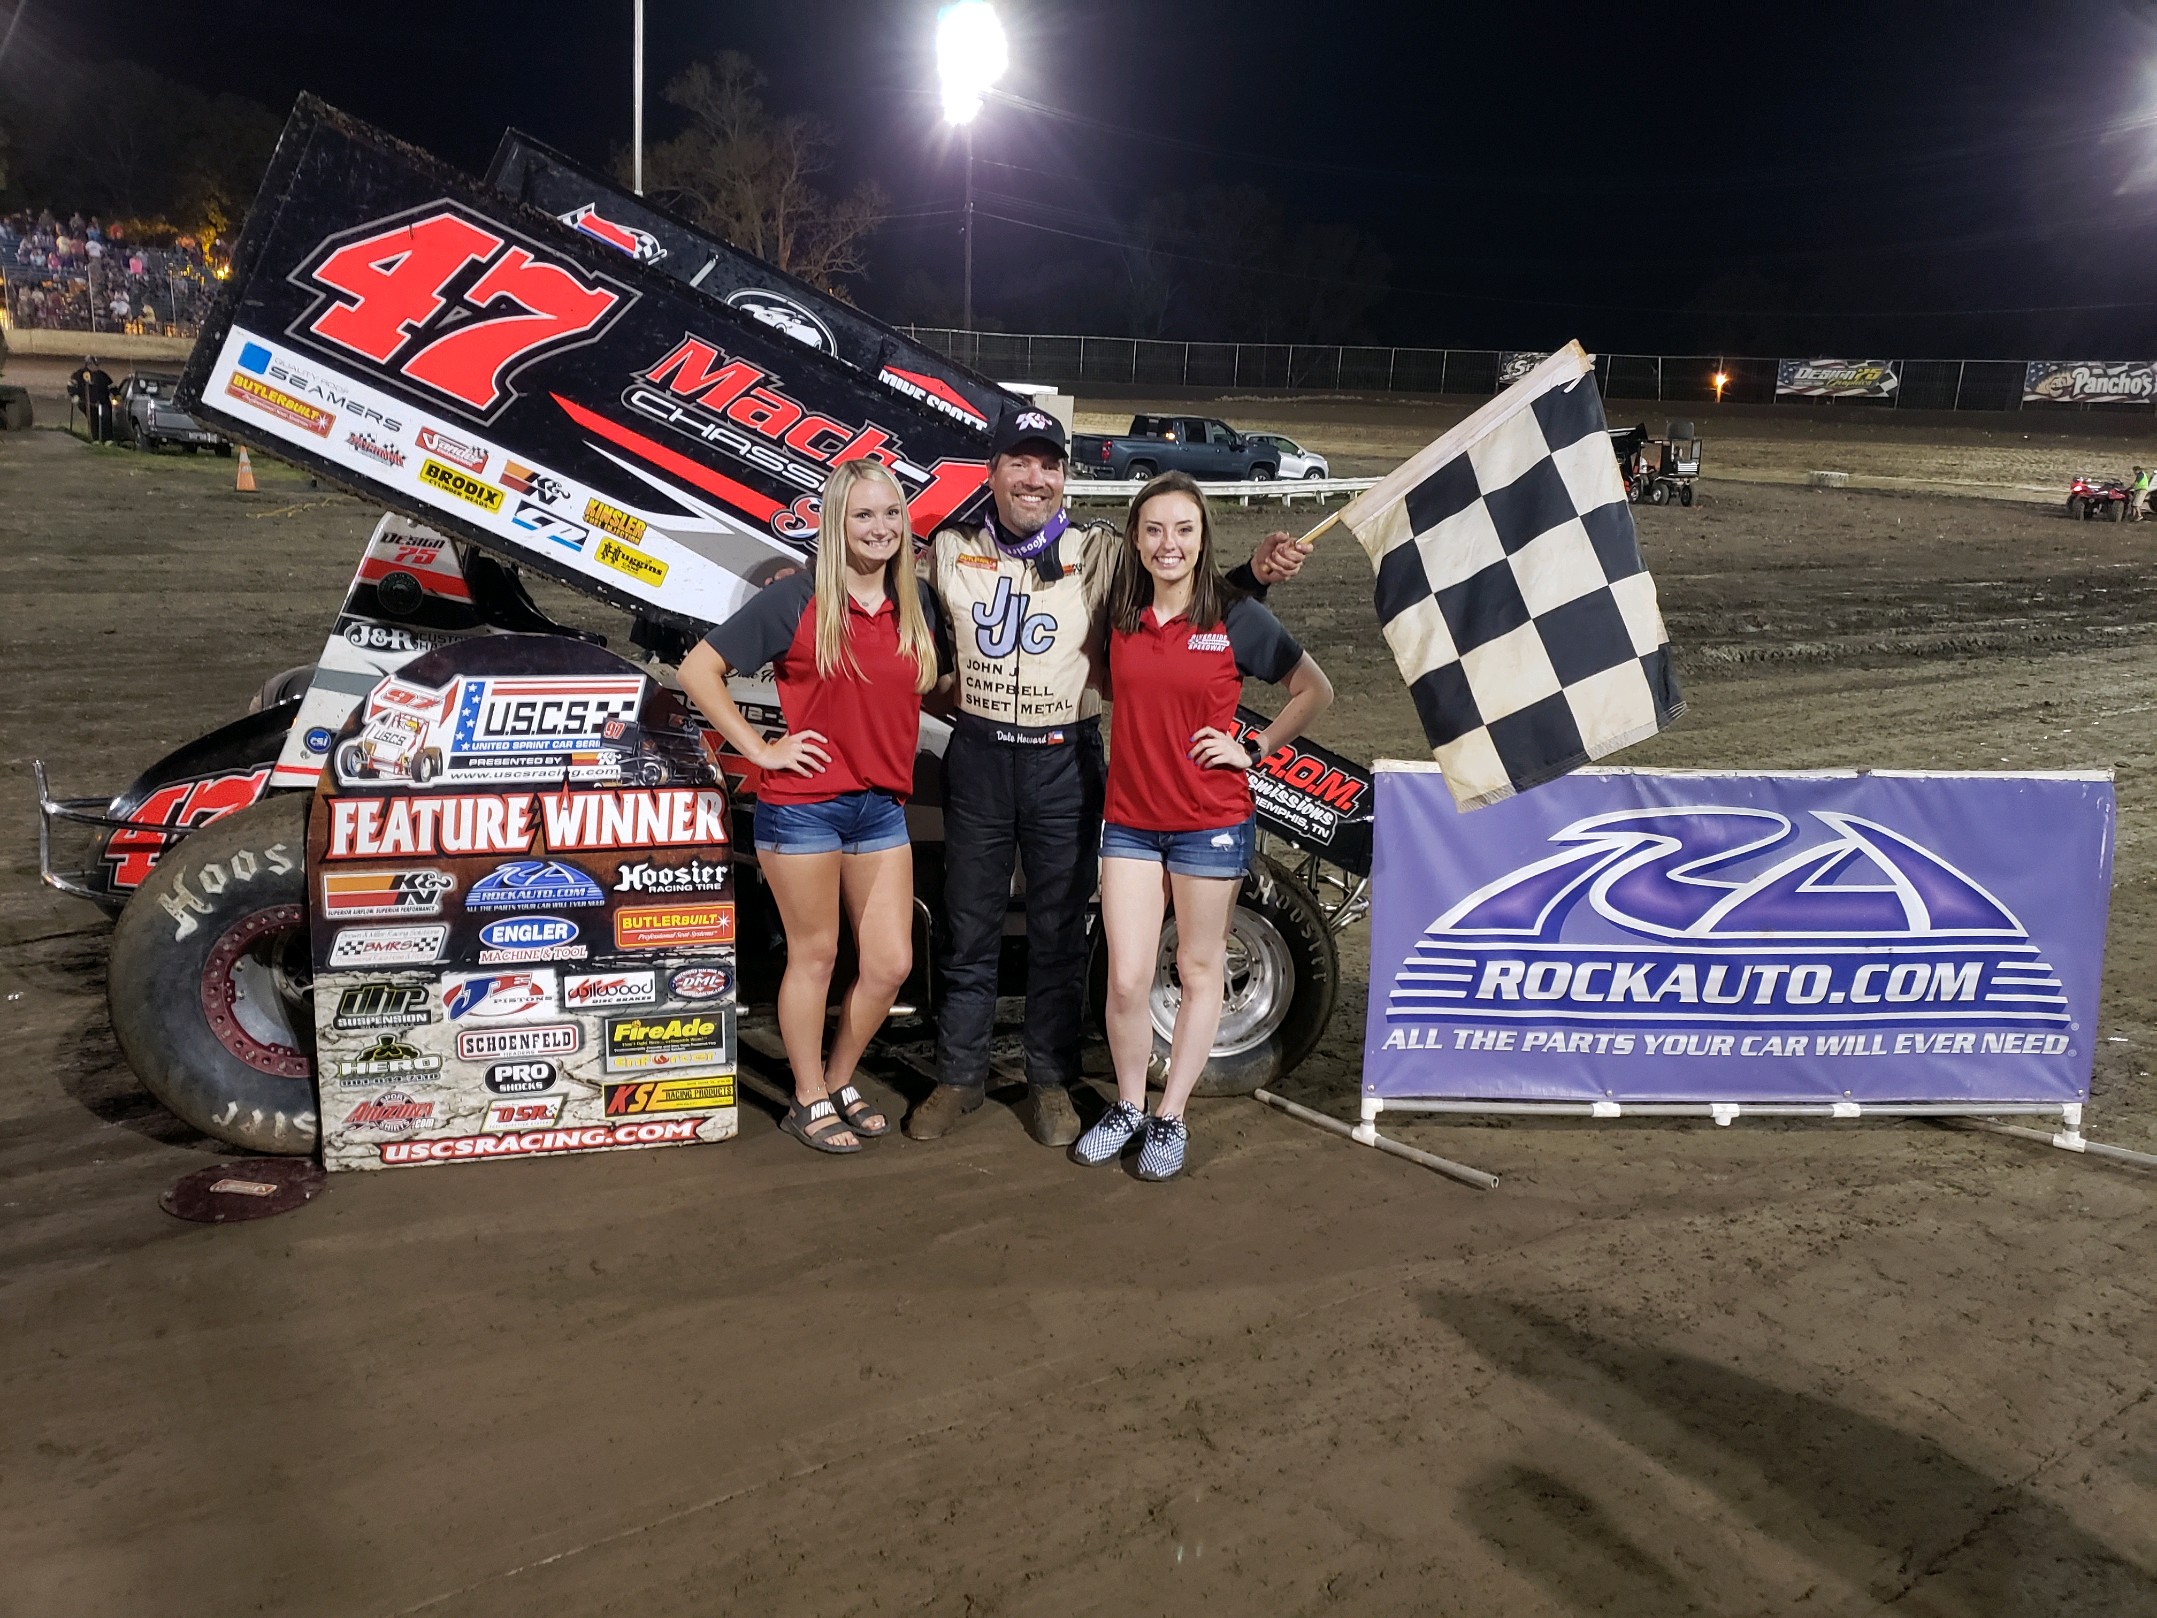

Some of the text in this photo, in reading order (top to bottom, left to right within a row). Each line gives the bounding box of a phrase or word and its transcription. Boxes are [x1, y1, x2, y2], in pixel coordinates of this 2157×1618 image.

[310, 213, 619, 410] 47
[2072, 367, 2152, 397] Pancho's
[269, 366, 402, 433] SEAMERS
[631, 390, 826, 492] CHASS
[426, 463, 500, 506] BRODIX
[465, 495, 489, 510] HEADS
[585, 497, 647, 539] KINSLER
[394, 546, 440, 565] 75
[602, 541, 663, 576] Huggins
[349, 624, 417, 650] J&R
[1188, 644, 1226, 652] SPEEDWAY
[967, 659, 1003, 675] JOHN
[966, 677, 1054, 697] CAMPBELL
[966, 694, 1073, 715] SHEET METAL
[603, 721, 627, 740] 97
[996, 730, 1048, 744] Dale Howard
[472, 739, 601, 751] UNITED SPRINT CAR SERI
[469, 756, 563, 767] PRESENTED BY
[450, 766, 620, 780] www.uscsracig.com
[105, 769, 272, 887] 47
[331, 789, 727, 856] FEATURE WINNER
[1311, 823, 1330, 838] TN
[613, 860, 728, 892] Hoosier
[481, 887, 586, 901] ROCKAUTO.COM
[648, 883, 722, 893] RACING TIRE
[622, 913, 718, 929] BUTLERBUILT
[492, 923, 569, 943] ENGLER
[362, 940, 414, 953] BMRS
[481, 947, 586, 961] MACHINE & TOOL
[1475, 960, 1984, 1004] ROCKAUTO.COM
[493, 996, 553, 1004] PISTONS
[616, 995, 653, 1003] BRAKES
[337, 1013, 428, 1028] SUSPENSION
[613, 1018, 715, 1042] FireAde
[465, 1031, 571, 1053] SCHOENFELD
[1381, 1028, 2070, 1057] ALL THE PARTS YOUR CAR WILL EVER NEED
[503, 1050, 535, 1058] HEADERS
[341, 1056, 440, 1075] HERO
[494, 1063, 549, 1082] PRO
[499, 1081, 543, 1092] SHOCKS
[665, 1086, 732, 1100] RACING PRODUCTS
[607, 1083, 665, 1114] KSE
[385, 1120, 695, 1160] USCSRACING.COM
